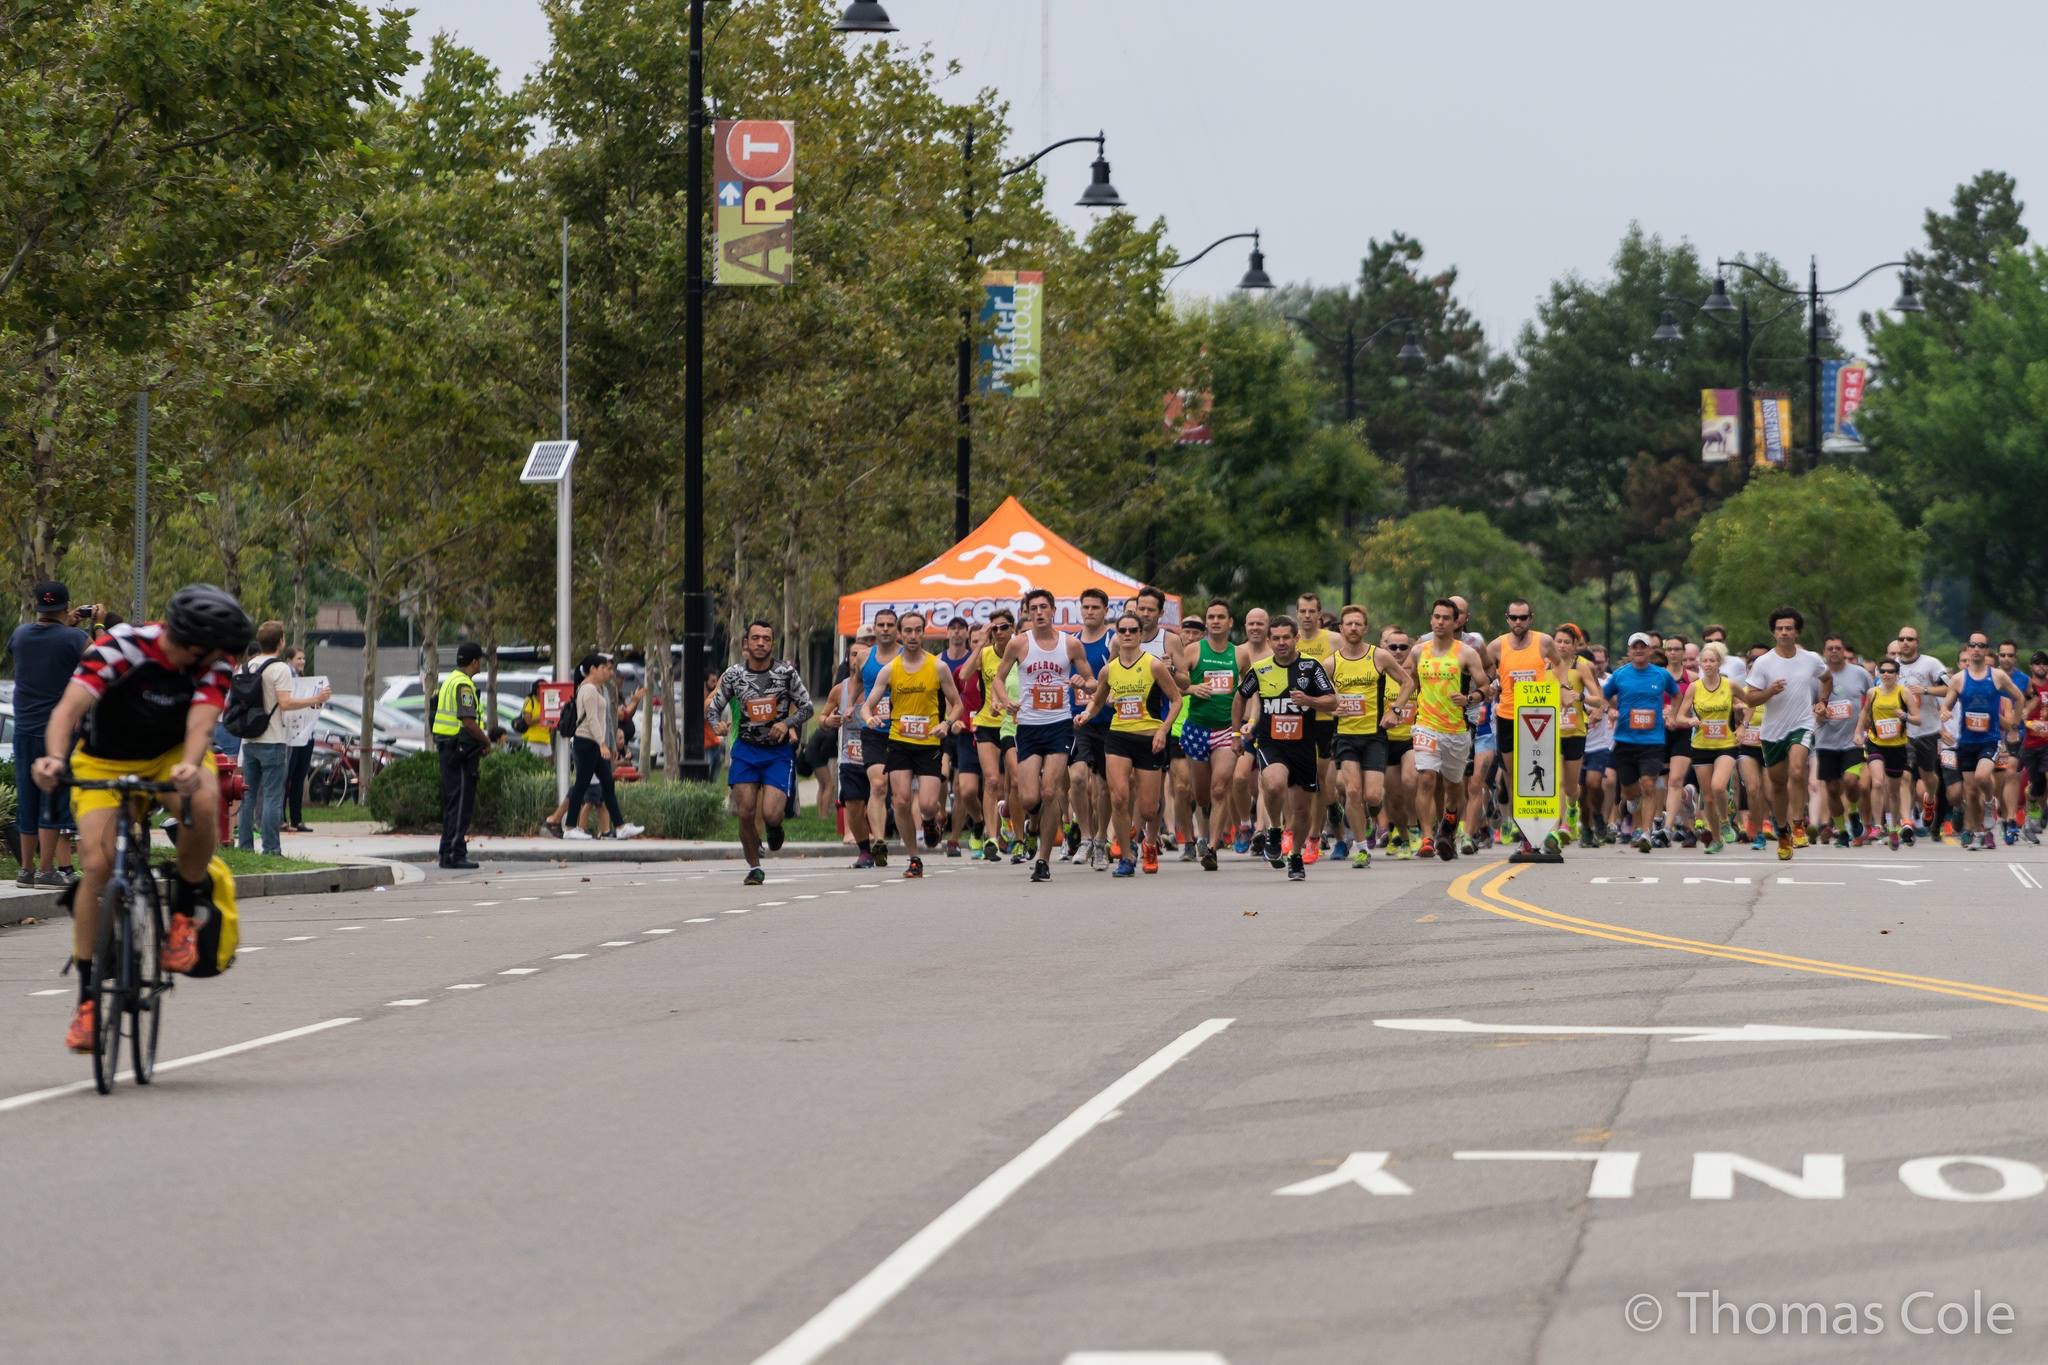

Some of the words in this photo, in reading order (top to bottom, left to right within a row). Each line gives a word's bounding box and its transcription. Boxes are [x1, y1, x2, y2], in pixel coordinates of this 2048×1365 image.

[723, 134, 794, 284] ART
[1010, 281, 1041, 368] front
[1026, 660, 1063, 675] MELROSE
[1522, 685, 1551, 694] STATE
[1039, 692, 1058, 703] 531
[1527, 696, 1547, 704] LAW
[752, 703, 773, 715] 578
[1120, 702, 1139, 714] 495
[1264, 698, 1310, 714] MR
[903, 722, 924, 734] 154
[1275, 721, 1298, 733] 507
[1532, 749, 1541, 757] TO
[1518, 807, 1555, 815] CROSSWALK
[1590, 876, 1934, 887] ONLY
[1273, 1150, 2048, 1201] ONLY
